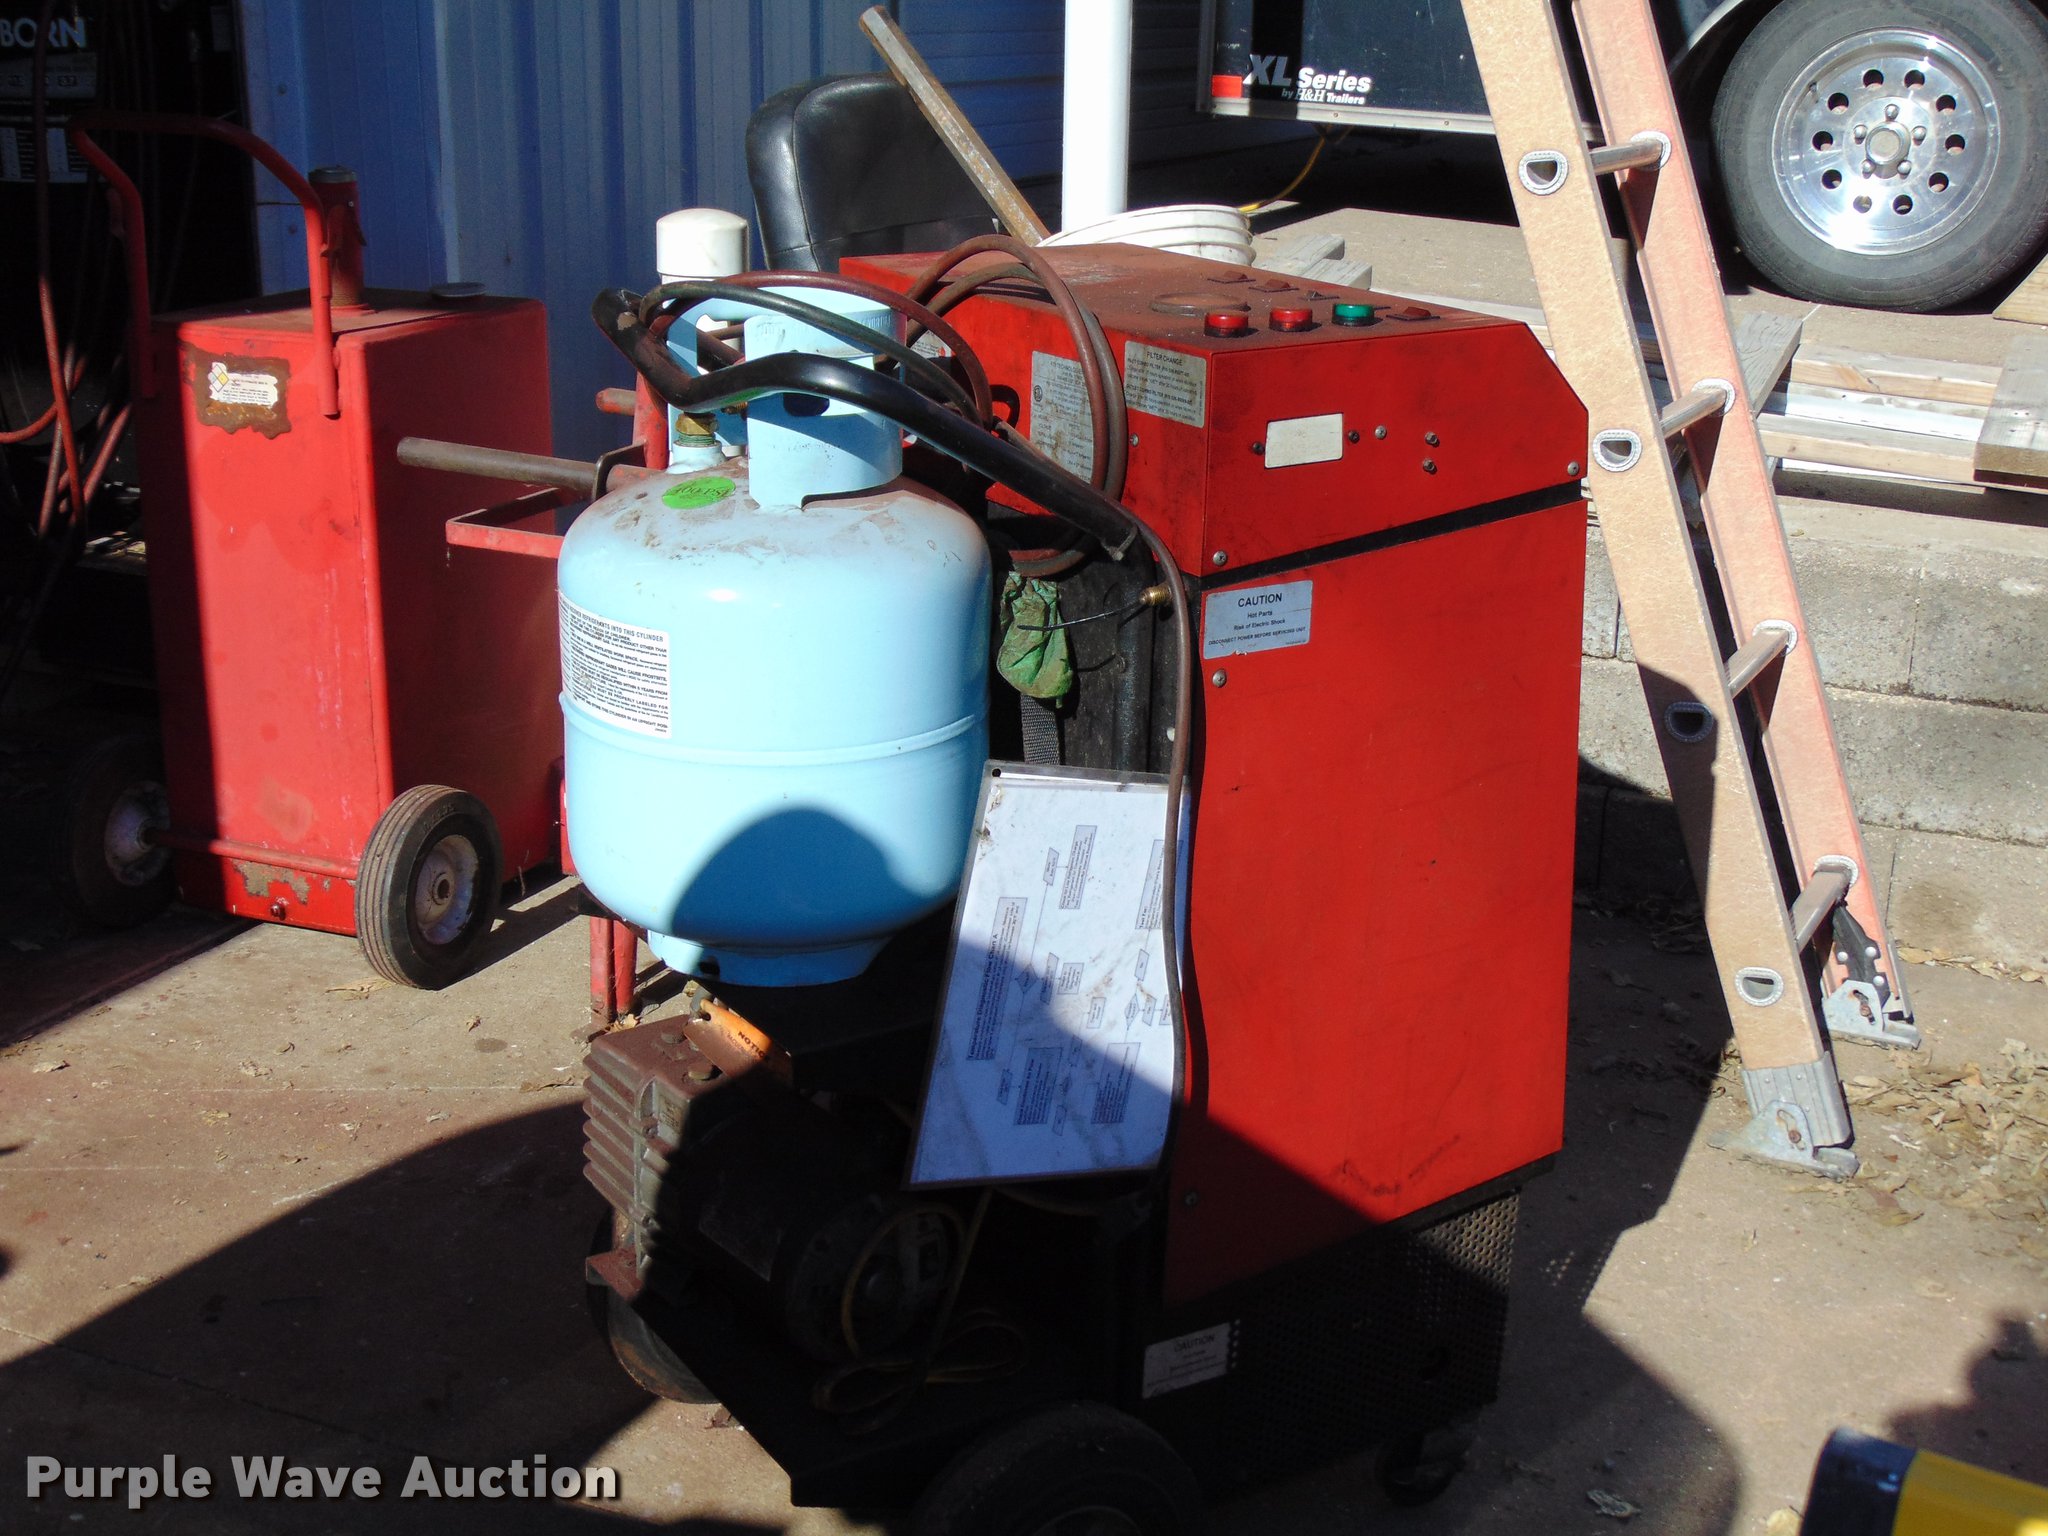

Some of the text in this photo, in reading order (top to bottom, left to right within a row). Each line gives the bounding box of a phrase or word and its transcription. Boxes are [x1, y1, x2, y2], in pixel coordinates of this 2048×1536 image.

[1242, 53, 1372, 93] XL Series
[1281, 88, 1366, 105] by H&H Trailers
[1238, 592, 1283, 608] CAUTION
[1247, 611, 1258, 619] Hot
[1233, 623, 1244, 631] Risk
[1251, 620, 1270, 628] Electric
[1270, 618, 1286, 626] Shock
[610, 624, 622, 633] INTO
[623, 627, 634, 636] THIS
[636, 631, 663, 642] CYLINDER
[1254, 631, 1271, 639] BEFORE
